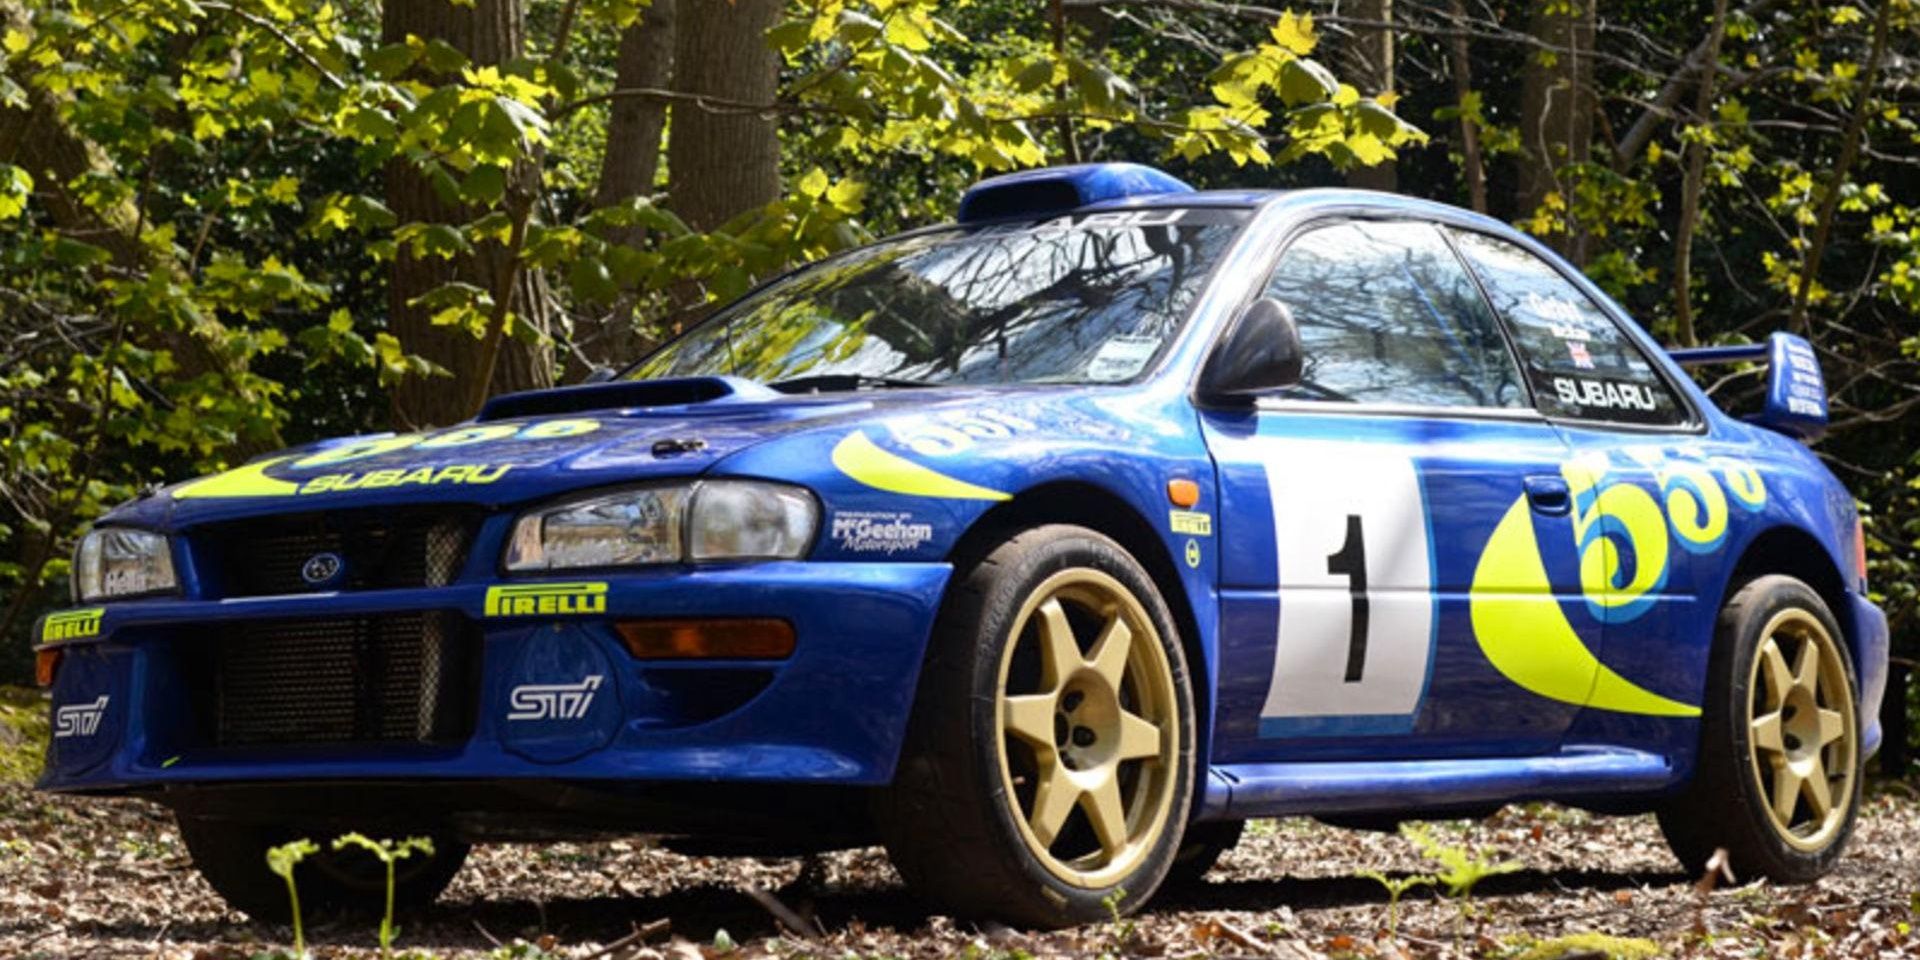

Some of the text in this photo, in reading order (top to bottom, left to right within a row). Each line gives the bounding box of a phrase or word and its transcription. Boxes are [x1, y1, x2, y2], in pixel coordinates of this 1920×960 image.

[1554, 377, 1656, 411] SUBARU
[299, 464, 512, 496] SUBARU
[832, 518, 932, 541] McGeehan
[484, 582, 609, 617] PIRELLI
[1327, 514, 1369, 683] 1
[43, 608, 105, 642] PIRELLI
